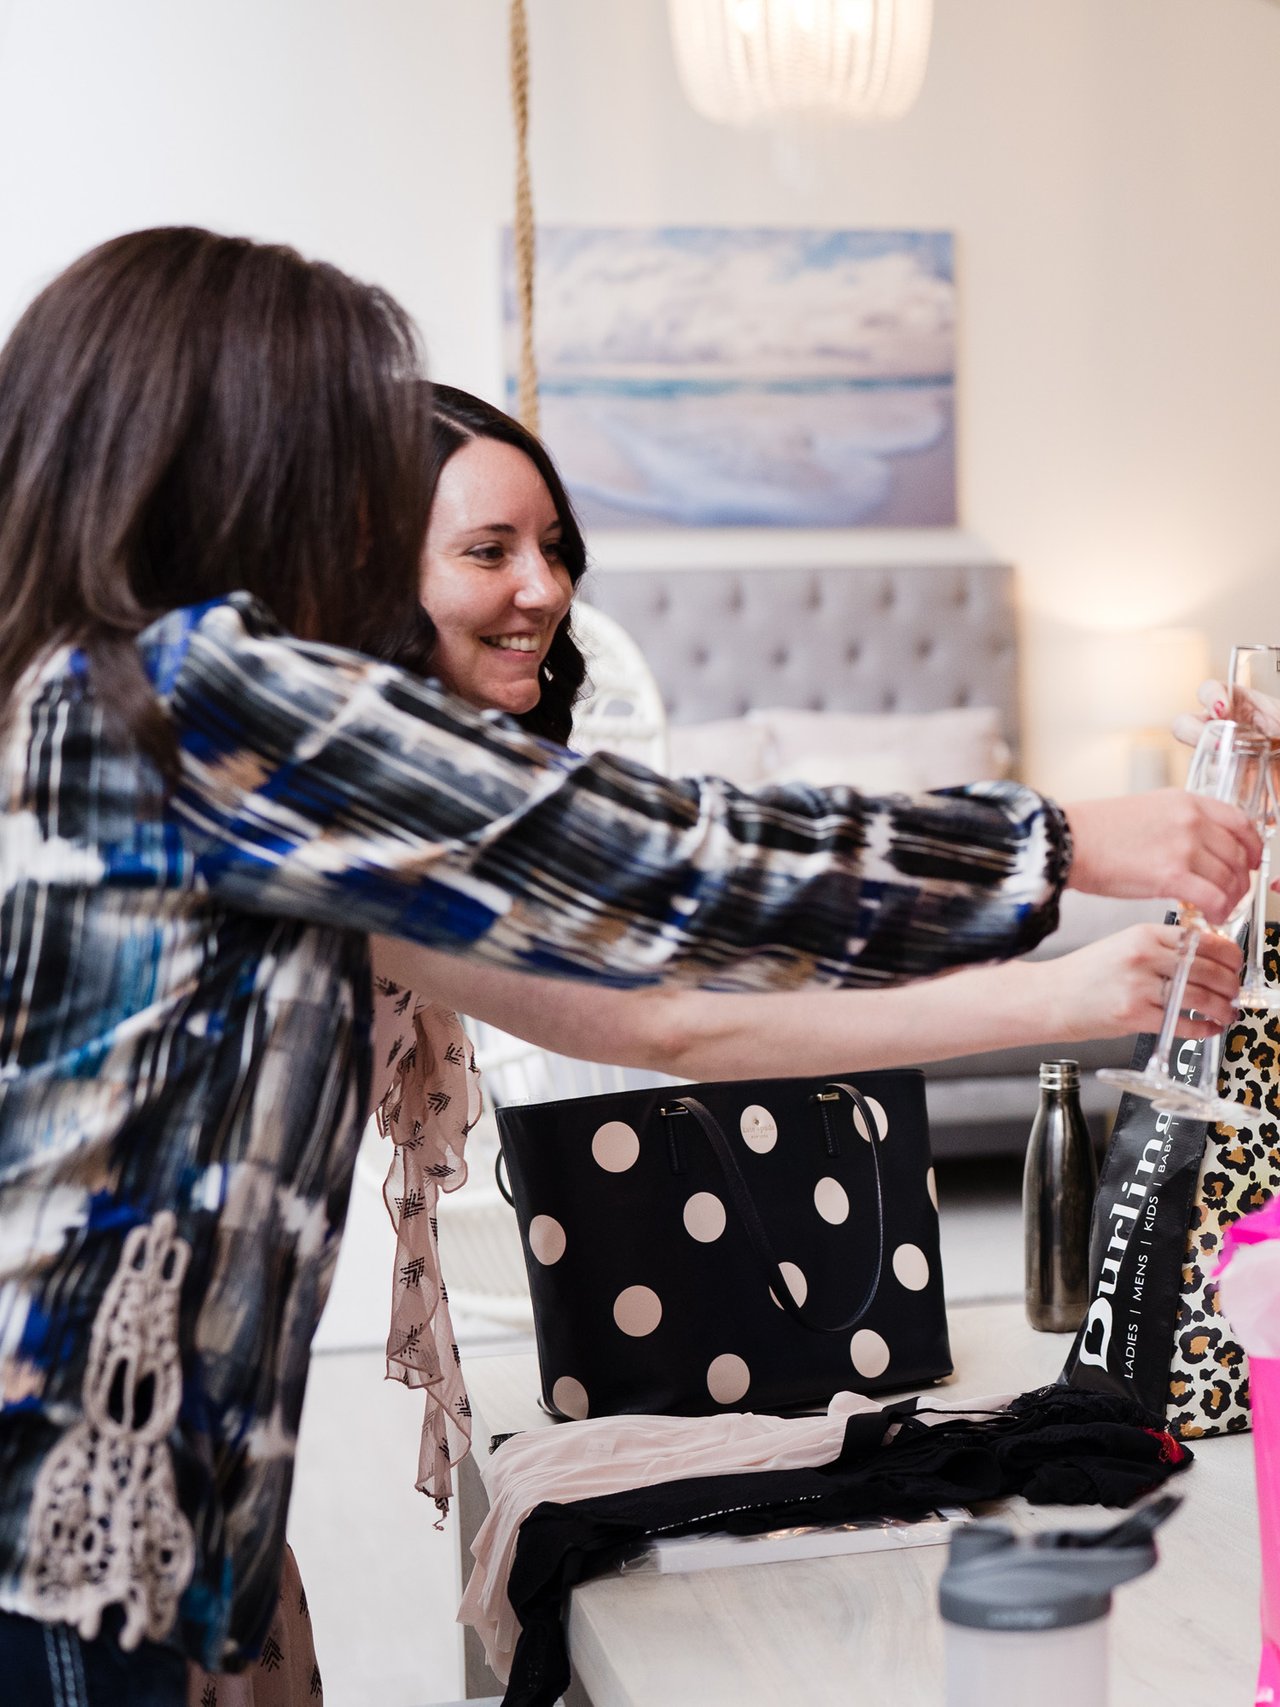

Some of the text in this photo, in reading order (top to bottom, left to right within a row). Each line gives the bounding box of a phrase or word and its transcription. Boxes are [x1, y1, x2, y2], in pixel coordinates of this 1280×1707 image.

[1123, 1323, 1139, 1379] LADIES
[1132, 1255, 1148, 1301] MENS
[1143, 1195, 1159, 1232] KIDS
[1157, 1134, 1174, 1173] BABY
